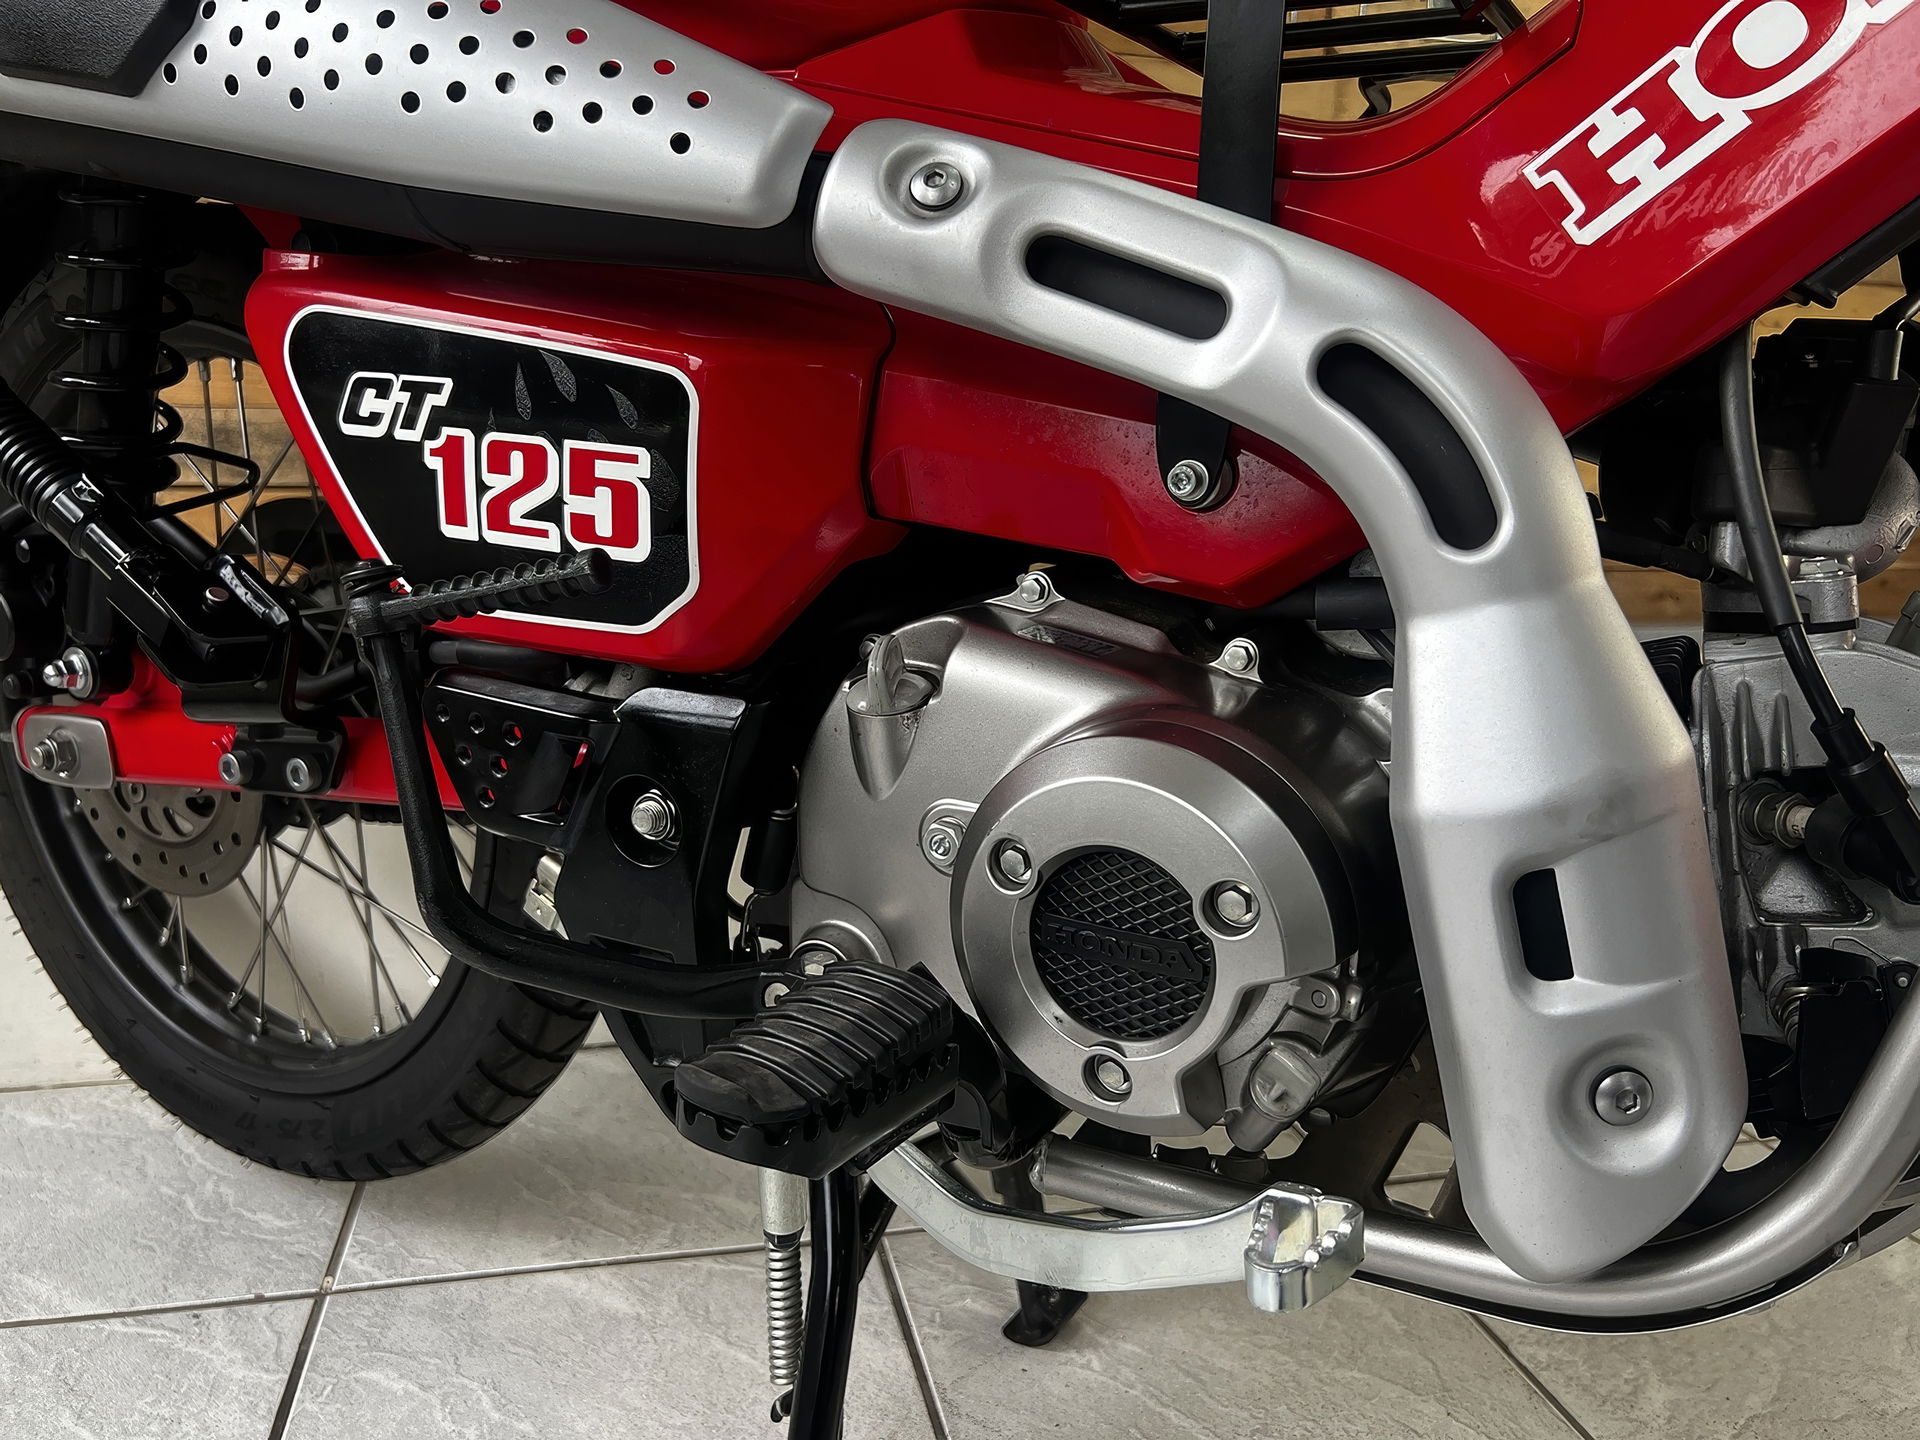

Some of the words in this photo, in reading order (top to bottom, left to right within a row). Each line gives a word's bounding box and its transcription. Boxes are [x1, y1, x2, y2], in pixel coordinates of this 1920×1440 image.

[1521, 0, 1917, 246] HO
[337, 370, 454, 442] CT
[424, 426, 652, 563] 125
[1045, 921, 1194, 973] HONDA
